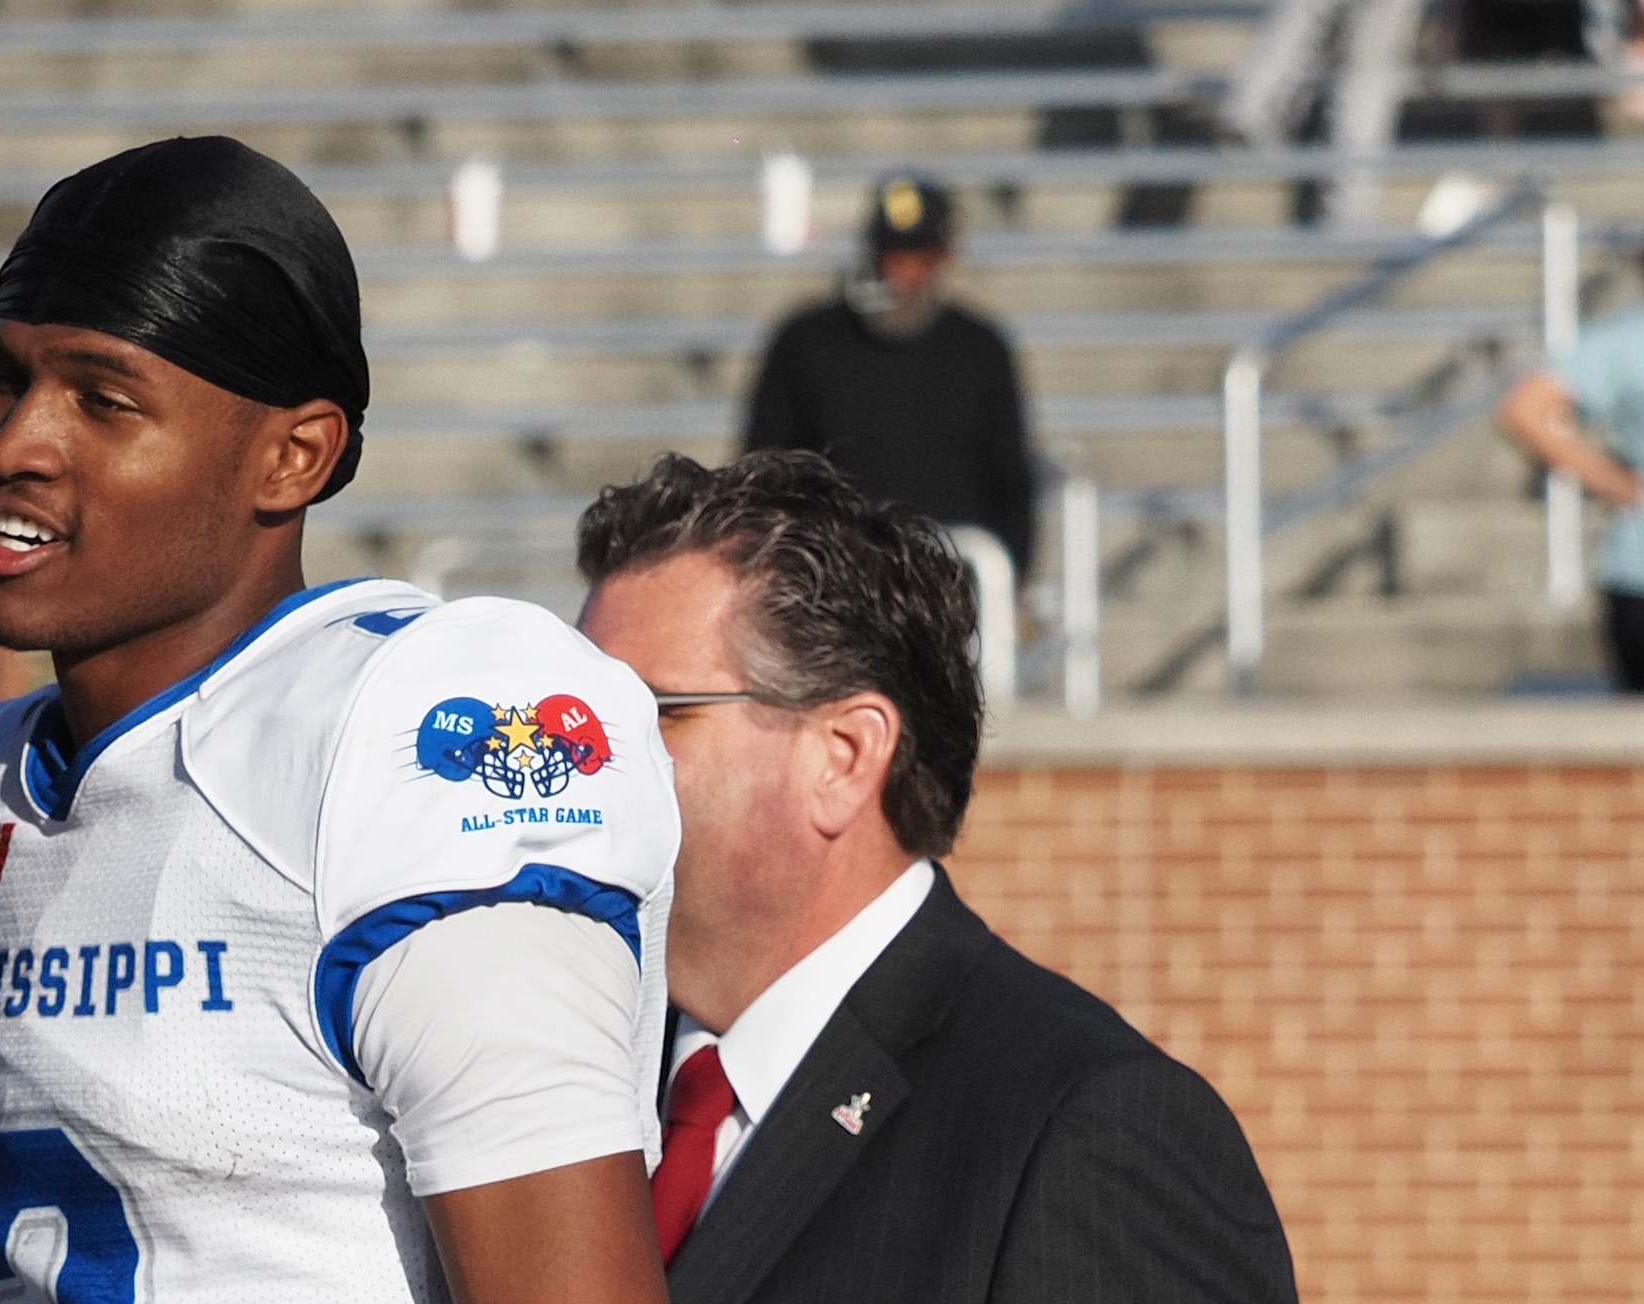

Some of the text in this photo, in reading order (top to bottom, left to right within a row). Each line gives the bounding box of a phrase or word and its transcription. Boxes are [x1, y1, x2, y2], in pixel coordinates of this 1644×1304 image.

[433, 711, 475, 735] MS
[561, 707, 588, 732] AL
[461, 807, 603, 832] ALL-STAR GAME
